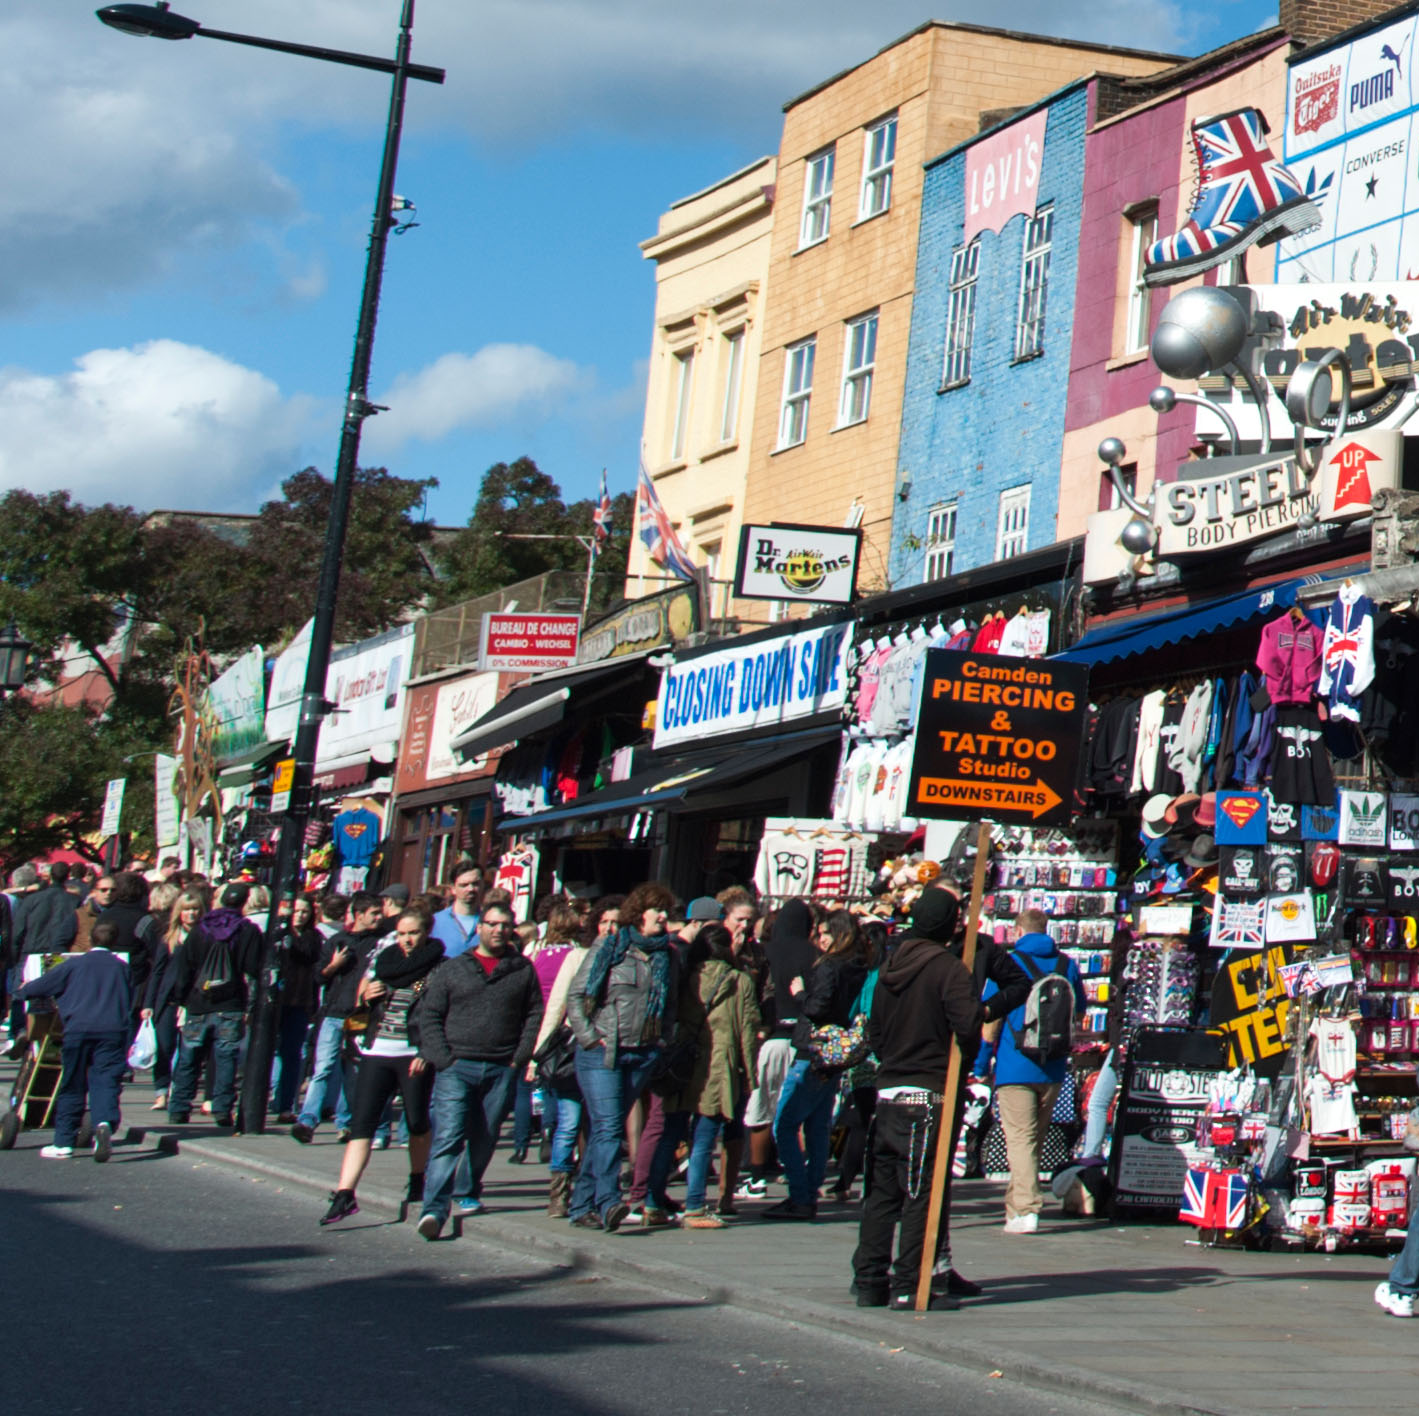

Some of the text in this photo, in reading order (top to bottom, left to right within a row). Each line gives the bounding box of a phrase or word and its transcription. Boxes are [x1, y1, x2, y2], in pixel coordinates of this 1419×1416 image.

[1295, 64, 1342, 94] Onitsuka
[1350, 68, 1394, 113] PUMA
[1298, 87, 1336, 128] Tiger
[1346, 139, 1405, 174] CONVERSE
[1342, 450, 1365, 468] UP
[1167, 460, 1310, 526] STEEL
[1187, 521, 1237, 547] BODY
[754, 554, 851, 575] Martens
[491, 621, 577, 636] BUREAU DE CHANGE
[494, 639, 529, 649] CAMBIO
[508, 659, 569, 668] COMMISSION
[961, 660, 1052, 686] Camden
[663, 624, 842, 731] CLOSING DOWN SALE
[932, 680, 1076, 712] PIERCING
[990, 711, 1012, 732] &
[938, 731, 1057, 762] TATTOO
[958, 757, 1032, 781] Studio
[925, 784, 1047, 807] DOWNSTAIRS
